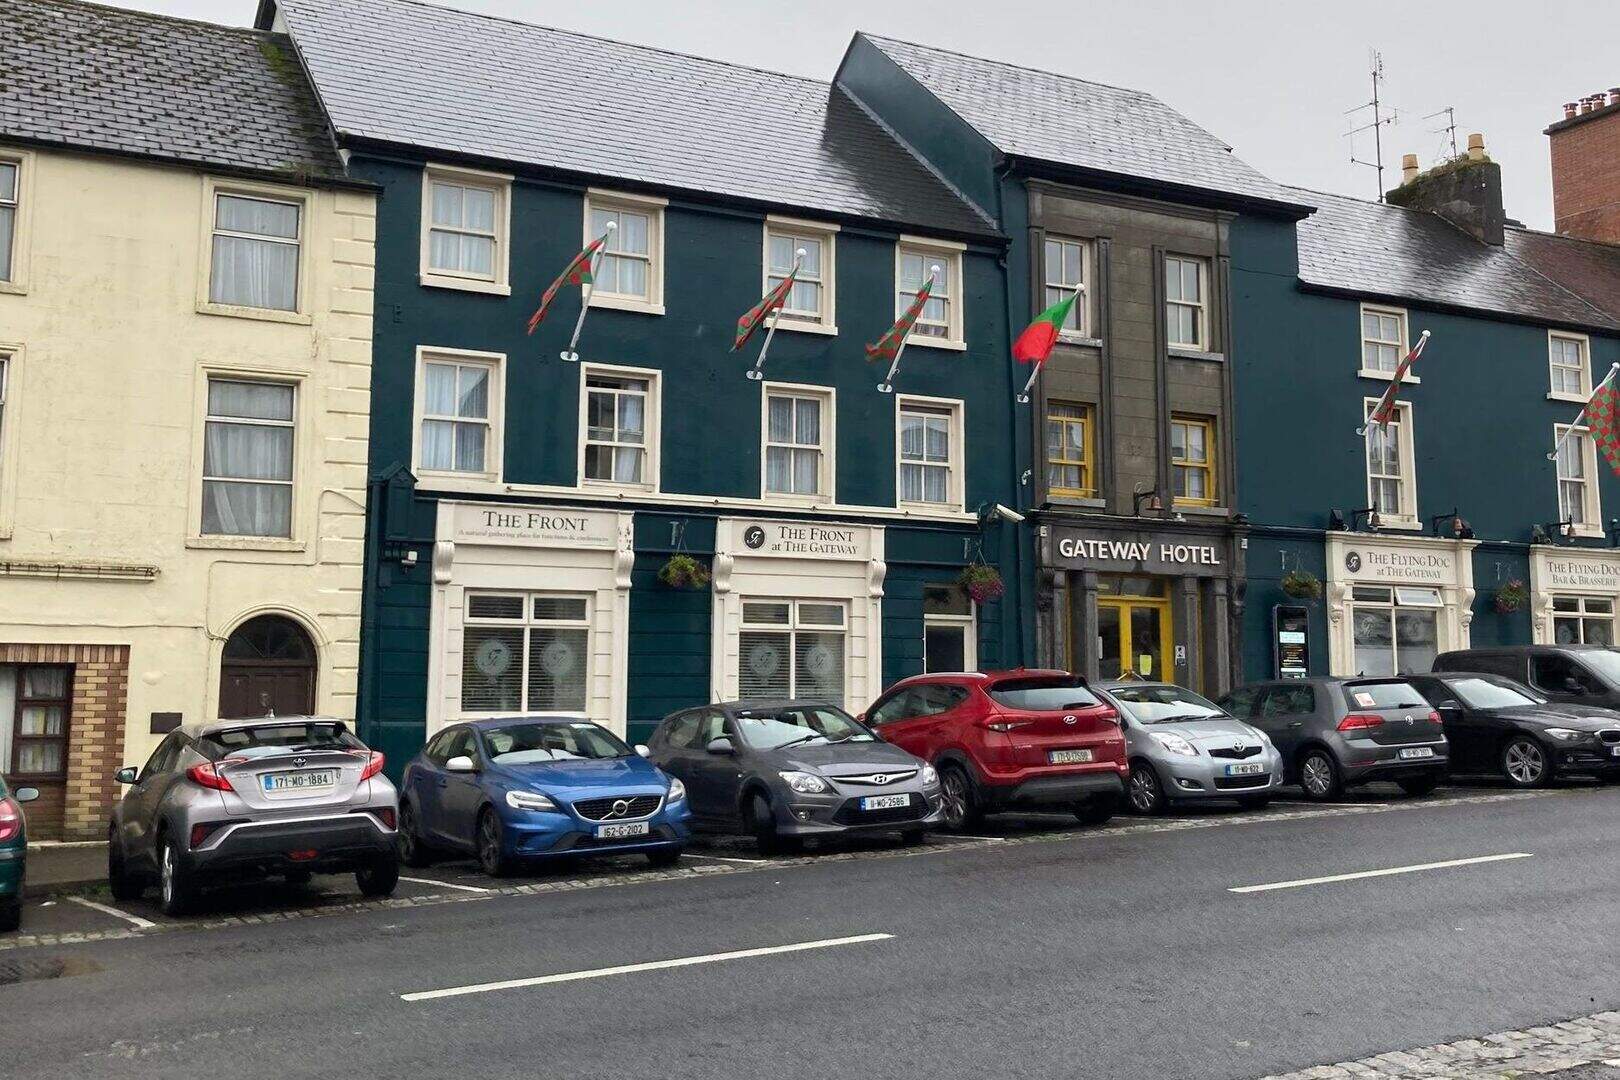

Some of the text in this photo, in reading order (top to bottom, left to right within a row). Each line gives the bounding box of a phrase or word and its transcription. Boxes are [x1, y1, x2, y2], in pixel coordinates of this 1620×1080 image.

[483, 511, 589, 531] THE FRONT
[778, 526, 806, 540] THE
[810, 527, 854, 542] FRONT
[771, 541, 858, 555] at THE GATEWAY
[1059, 538, 1221, 566] GATEWAY HOTEL
[1367, 552, 1389, 565] THE
[1391, 553, 1426, 566] FLYING
[1427, 555, 1450, 568] DOC
[1376, 566, 1441, 579] at THE GATEWAY
[1547, 561, 1566, 573] THE
[1568, 562, 1600, 575] FLYING
[1552, 574, 1617, 586] BAR & BRASSERIE
[275, 774, 328, 788] 171-MO-1884
